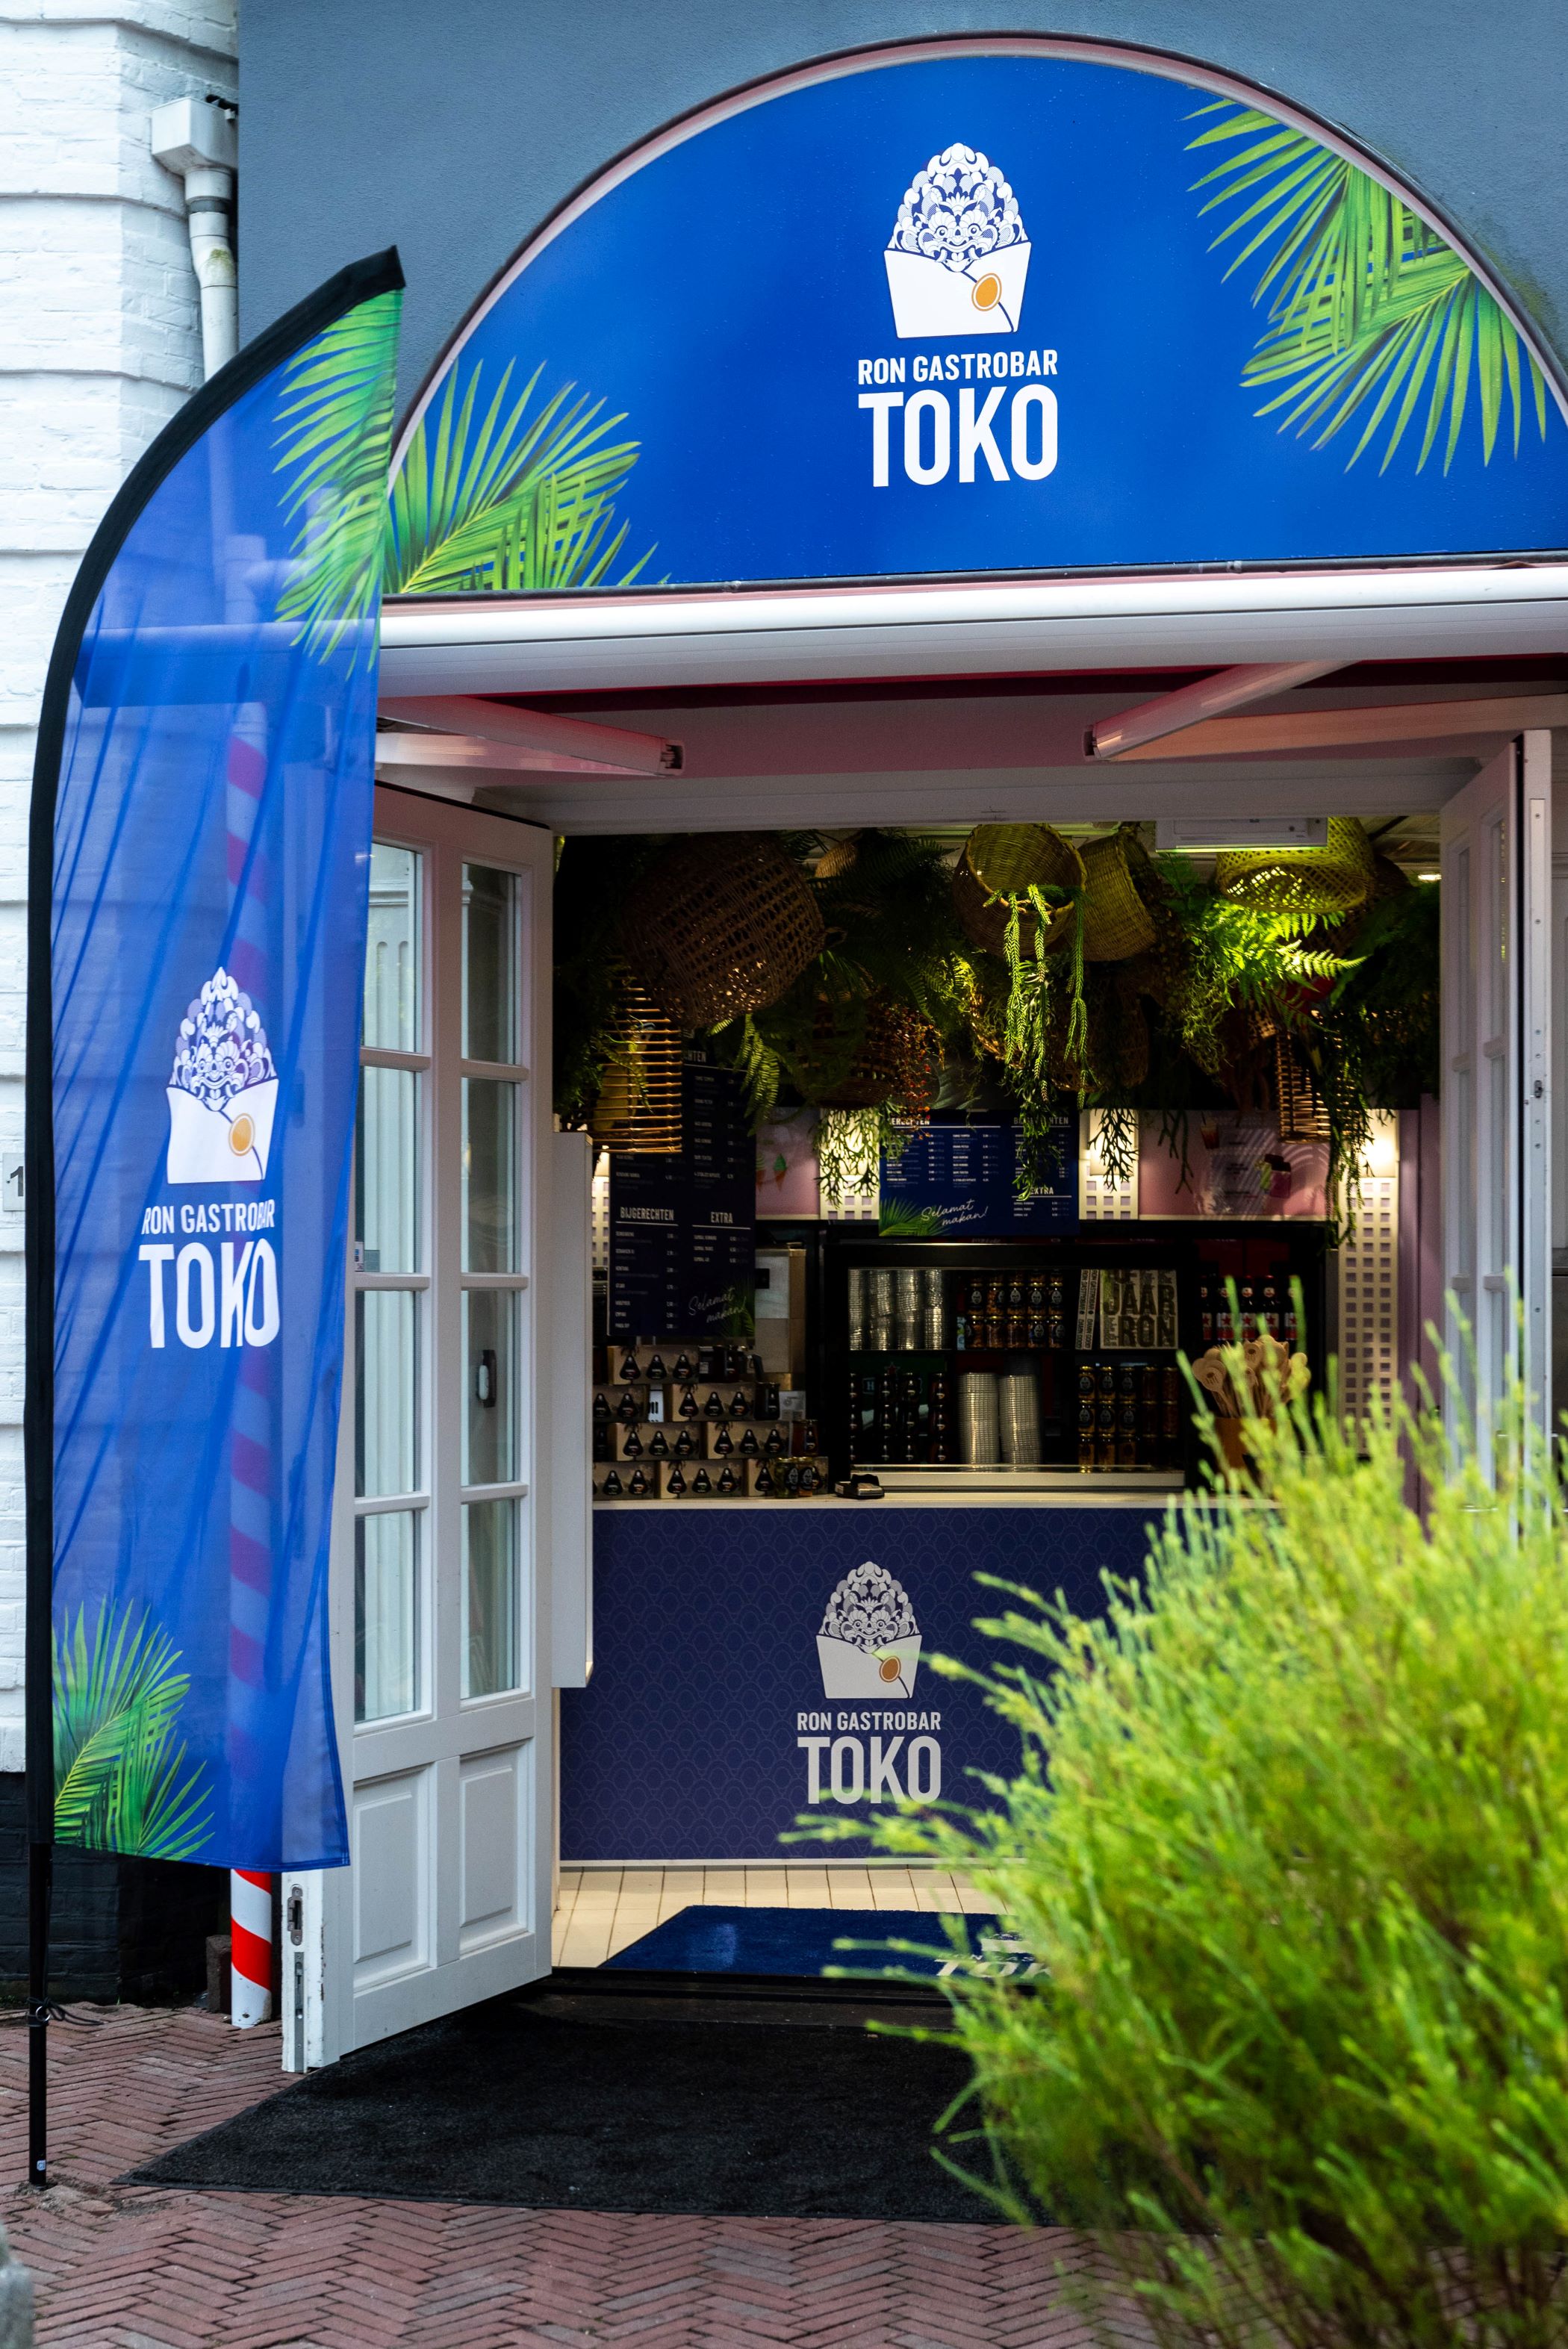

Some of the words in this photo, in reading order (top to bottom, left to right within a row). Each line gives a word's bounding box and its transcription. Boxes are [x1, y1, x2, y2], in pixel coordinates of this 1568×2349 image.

[859, 358, 906, 385] RON
[913, 349, 1058, 382] GASTROBAR
[859, 384, 1058, 487] TOKO
[141, 1206, 175, 1234] RON
[620, 1207, 674, 1221] BIJGERECHTEN
[711, 1212, 733, 1224] EXTRA
[921, 1198, 975, 1221] Selamat
[942, 1206, 989, 1226] makan!
[138, 1238, 280, 1349] TOKO
[688, 1287, 735, 1316] Selamat
[1104, 1283, 1176, 1315] JAAR
[1119, 1315, 1175, 1347] RON
[797, 1712, 832, 1731] RON
[837, 1711, 941, 1731] GASTROBAR
[797, 1735, 941, 1805] TOKO
[934, 1958, 1053, 1979] TOK
